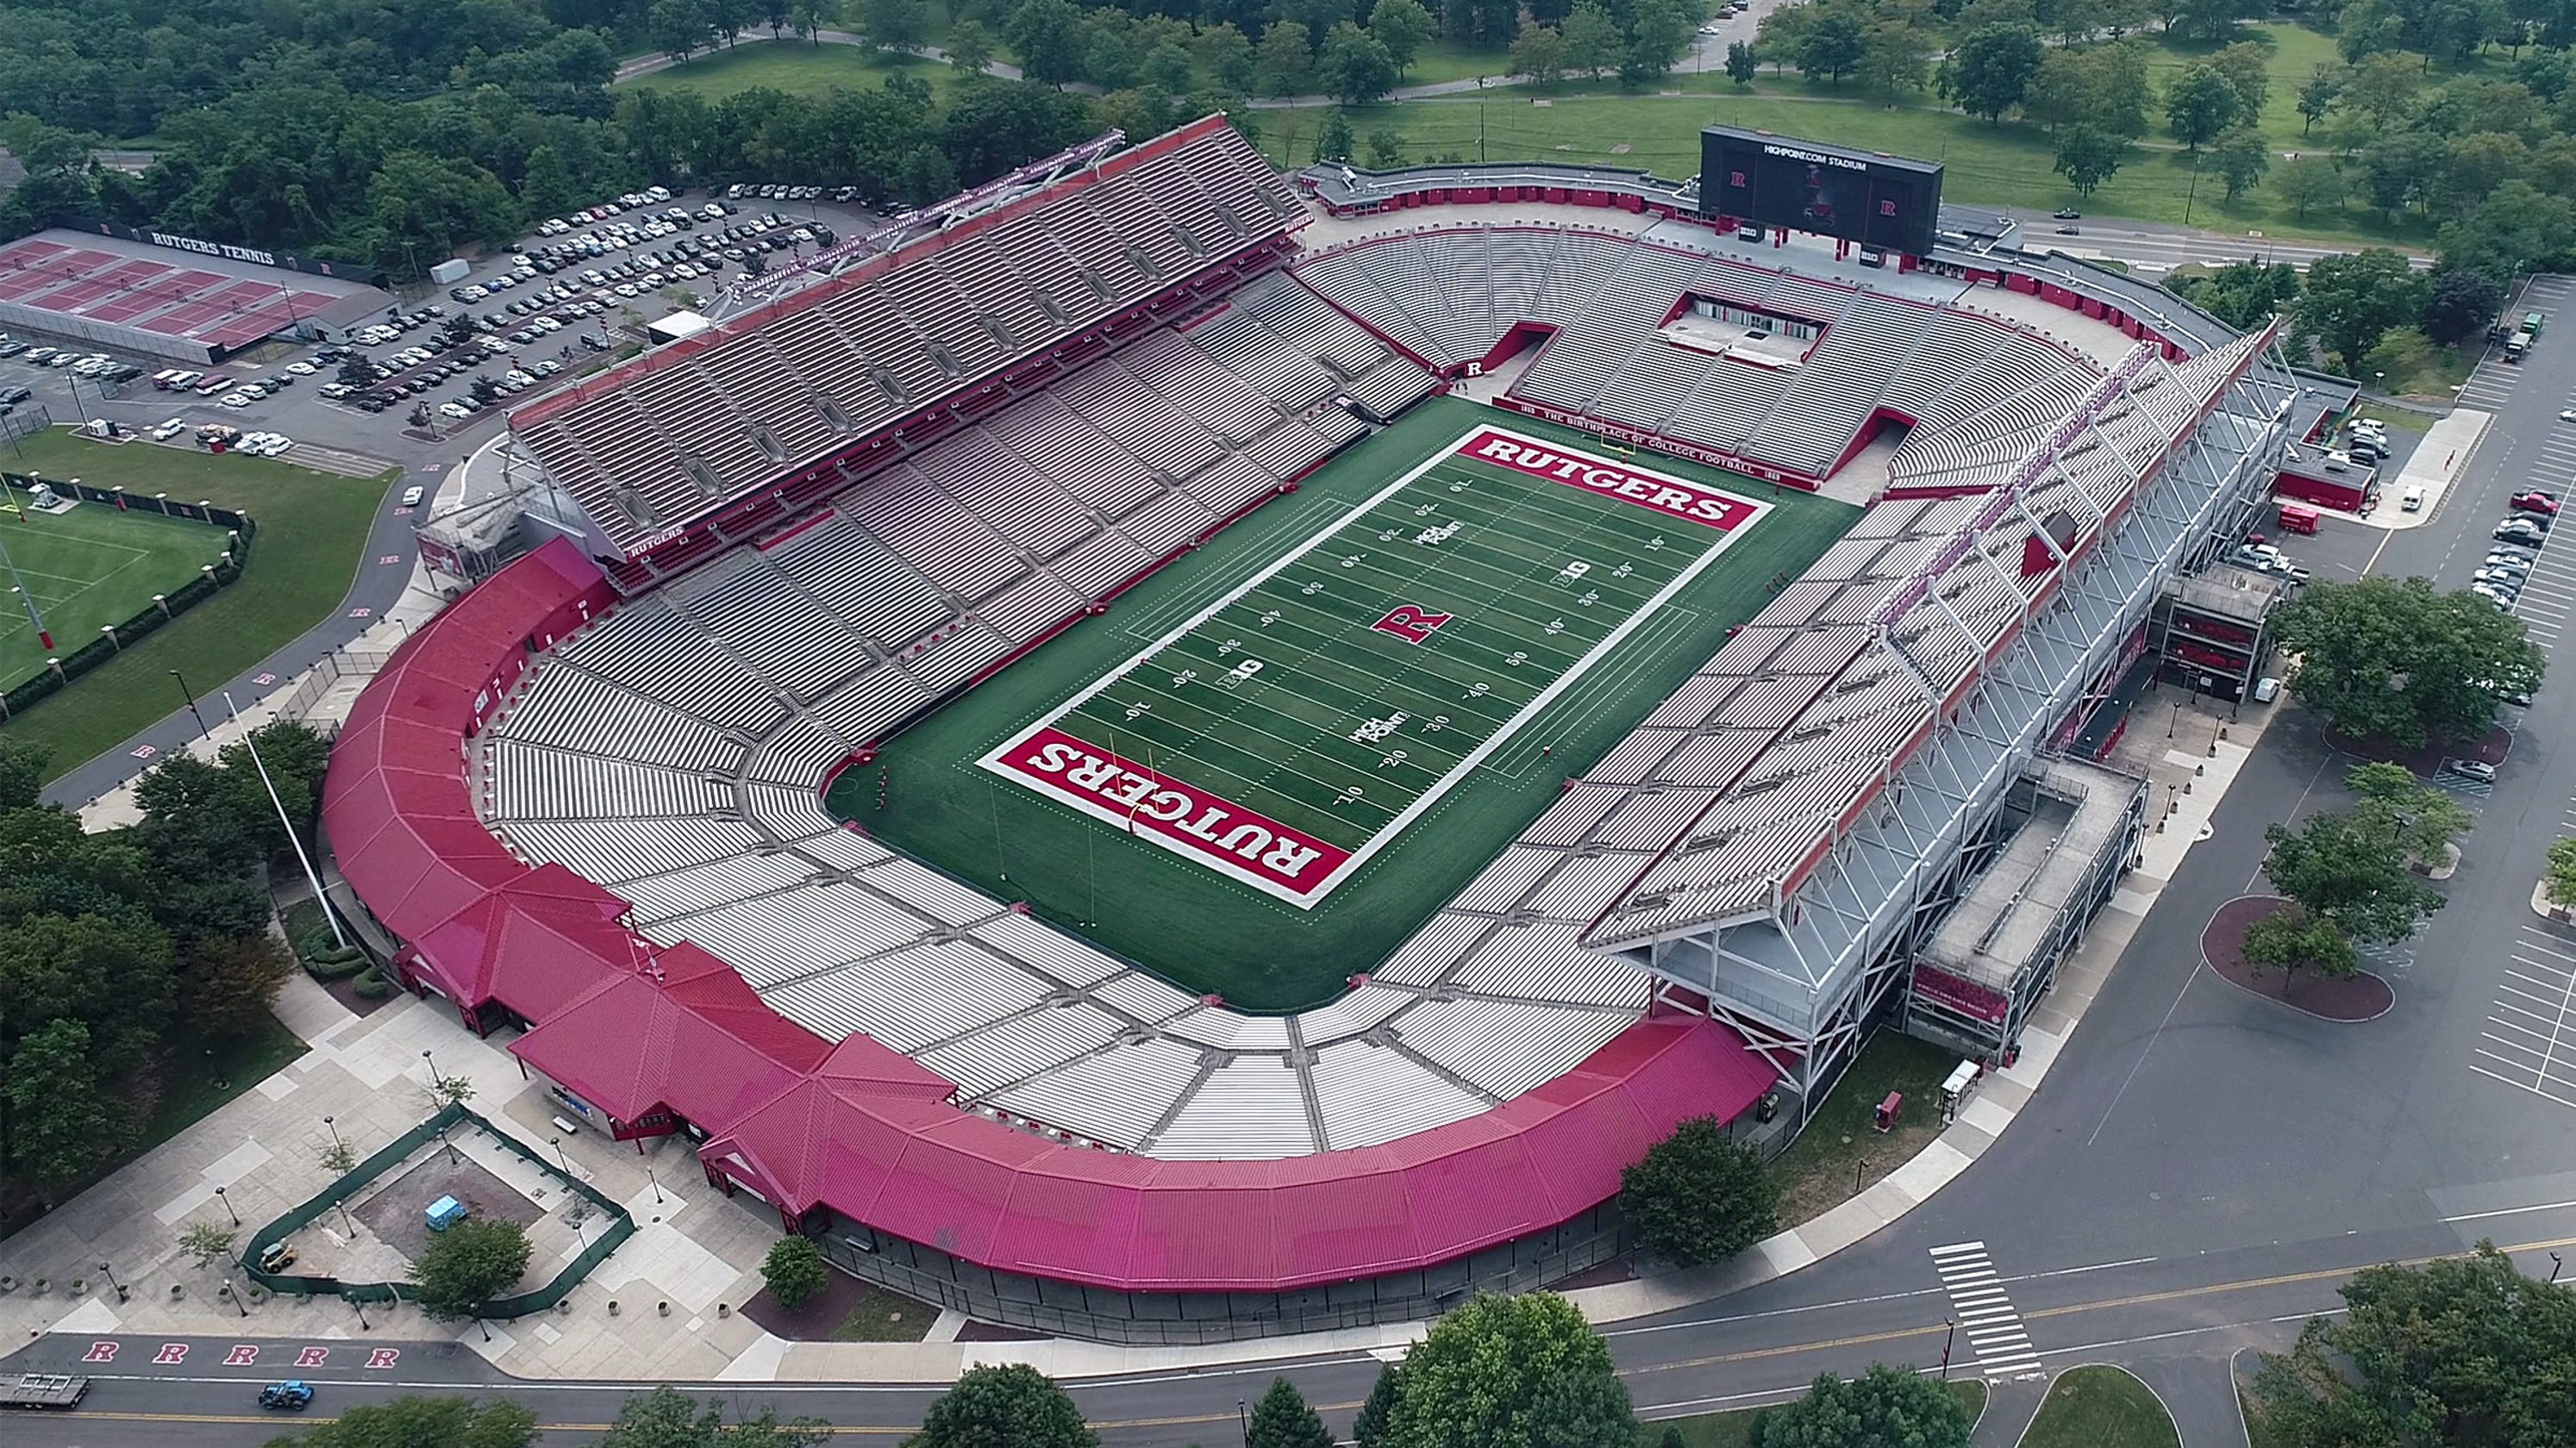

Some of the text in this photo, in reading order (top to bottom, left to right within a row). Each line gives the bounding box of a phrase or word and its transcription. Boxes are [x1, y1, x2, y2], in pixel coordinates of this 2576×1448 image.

[1764, 145, 1866, 171] HIGHPOINT.COM STADIUM
[1731, 172, 1745, 188] R
[1881, 200, 1896, 215] R
[152, 233, 274, 265] RUTGERS TENNIS
[1467, 362, 1483, 376] R
[1544, 411, 1563, 422] THE
[1567, 417, 1628, 439] BIRTHPLACE
[1648, 439, 1695, 458] COLLEGE
[1699, 452, 1754, 474] FOOTBALL
[1477, 439, 1732, 521] RUTGERS
[1415, 504, 1435, 515] 20
[631, 526, 685, 557] RUTGERS
[1412, 526, 1441, 544] HIGH
[1645, 538, 1664, 551] 10
[1341, 555, 1360, 568] 40
[1612, 564, 1633, 577] 20
[1302, 582, 1324, 595] 50
[1578, 592, 1598, 606] 30
[1260, 609, 1282, 624] 40
[1369, 604, 1454, 645] R
[1545, 621, 1564, 634] 40
[1218, 639, 1241, 653] 30
[1505, 651, 1528, 665] 50
[1172, 669, 1197, 685] 20
[1469, 683, 1490, 697] 40
[1126, 702, 1151, 719] 10
[1348, 717, 1384, 741] HIGH
[1367, 711, 1406, 743] POINT
[1425, 715, 1450, 731] 30
[1384, 750, 1407, 766] 20
[1338, 786, 1363, 803] 10
[1027, 743, 1322, 877] RUTGERS
[83, 1341, 120, 1362] R
[153, 1344, 189, 1364] R
[223, 1345, 259, 1365] R
[294, 1346, 329, 1367] R
[365, 1348, 400, 1369] R
